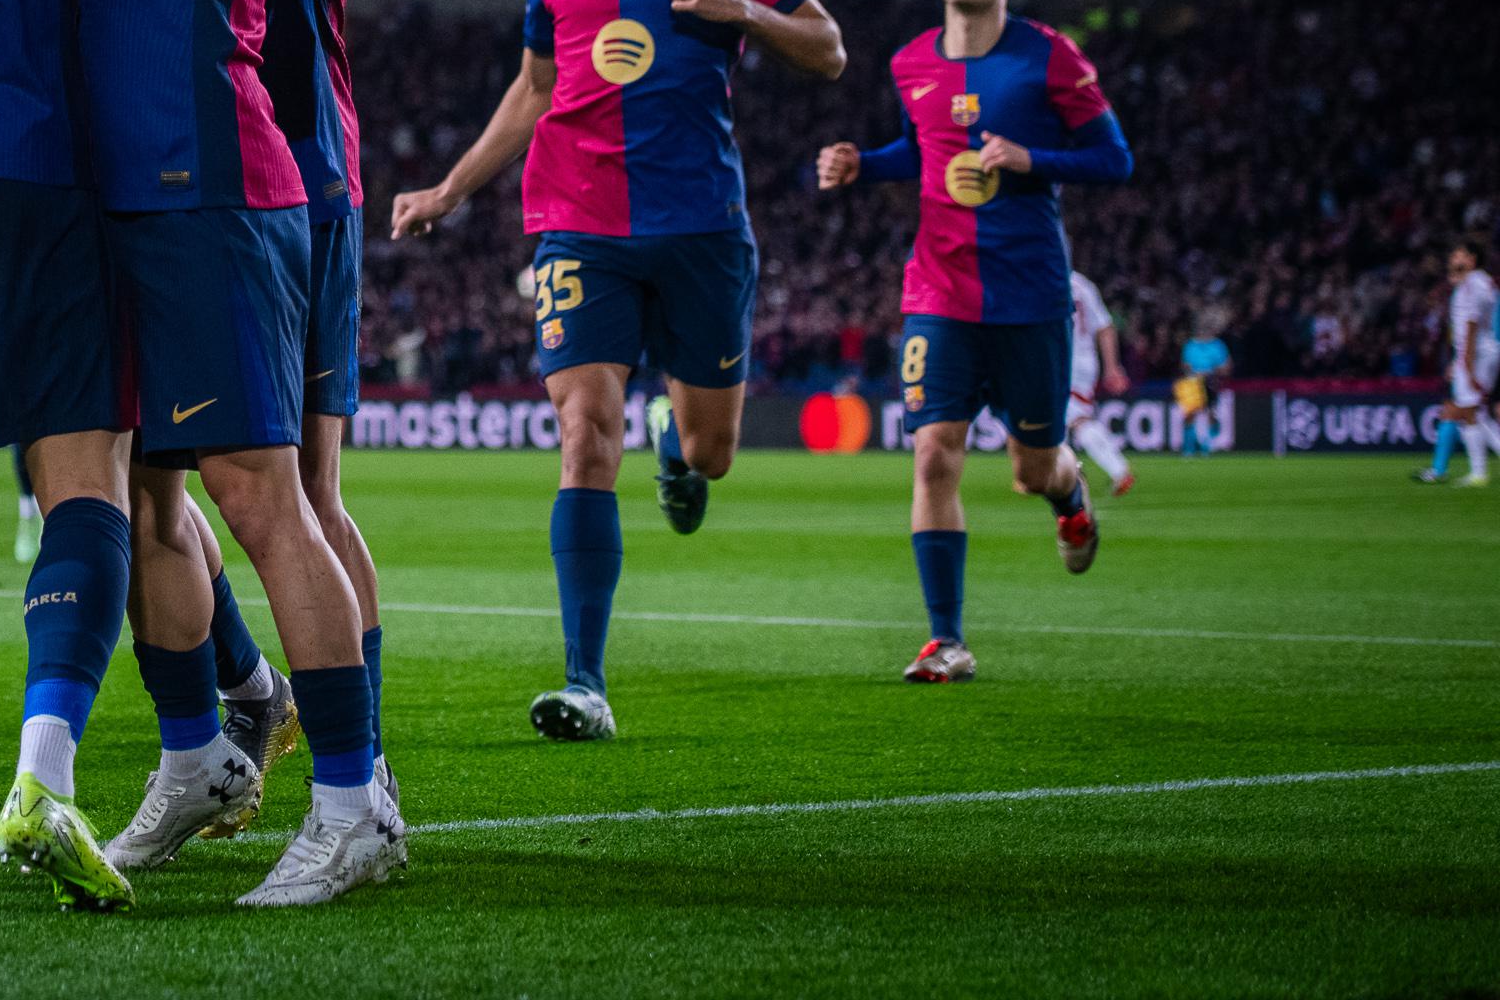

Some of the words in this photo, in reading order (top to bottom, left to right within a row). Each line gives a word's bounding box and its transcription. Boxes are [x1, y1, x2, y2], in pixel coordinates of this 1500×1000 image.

[536, 259, 584, 321] 35
[901, 335, 928, 383] 8
[352, 392, 647, 449] mastercd
[1323, 405, 1416, 445] UEFA
